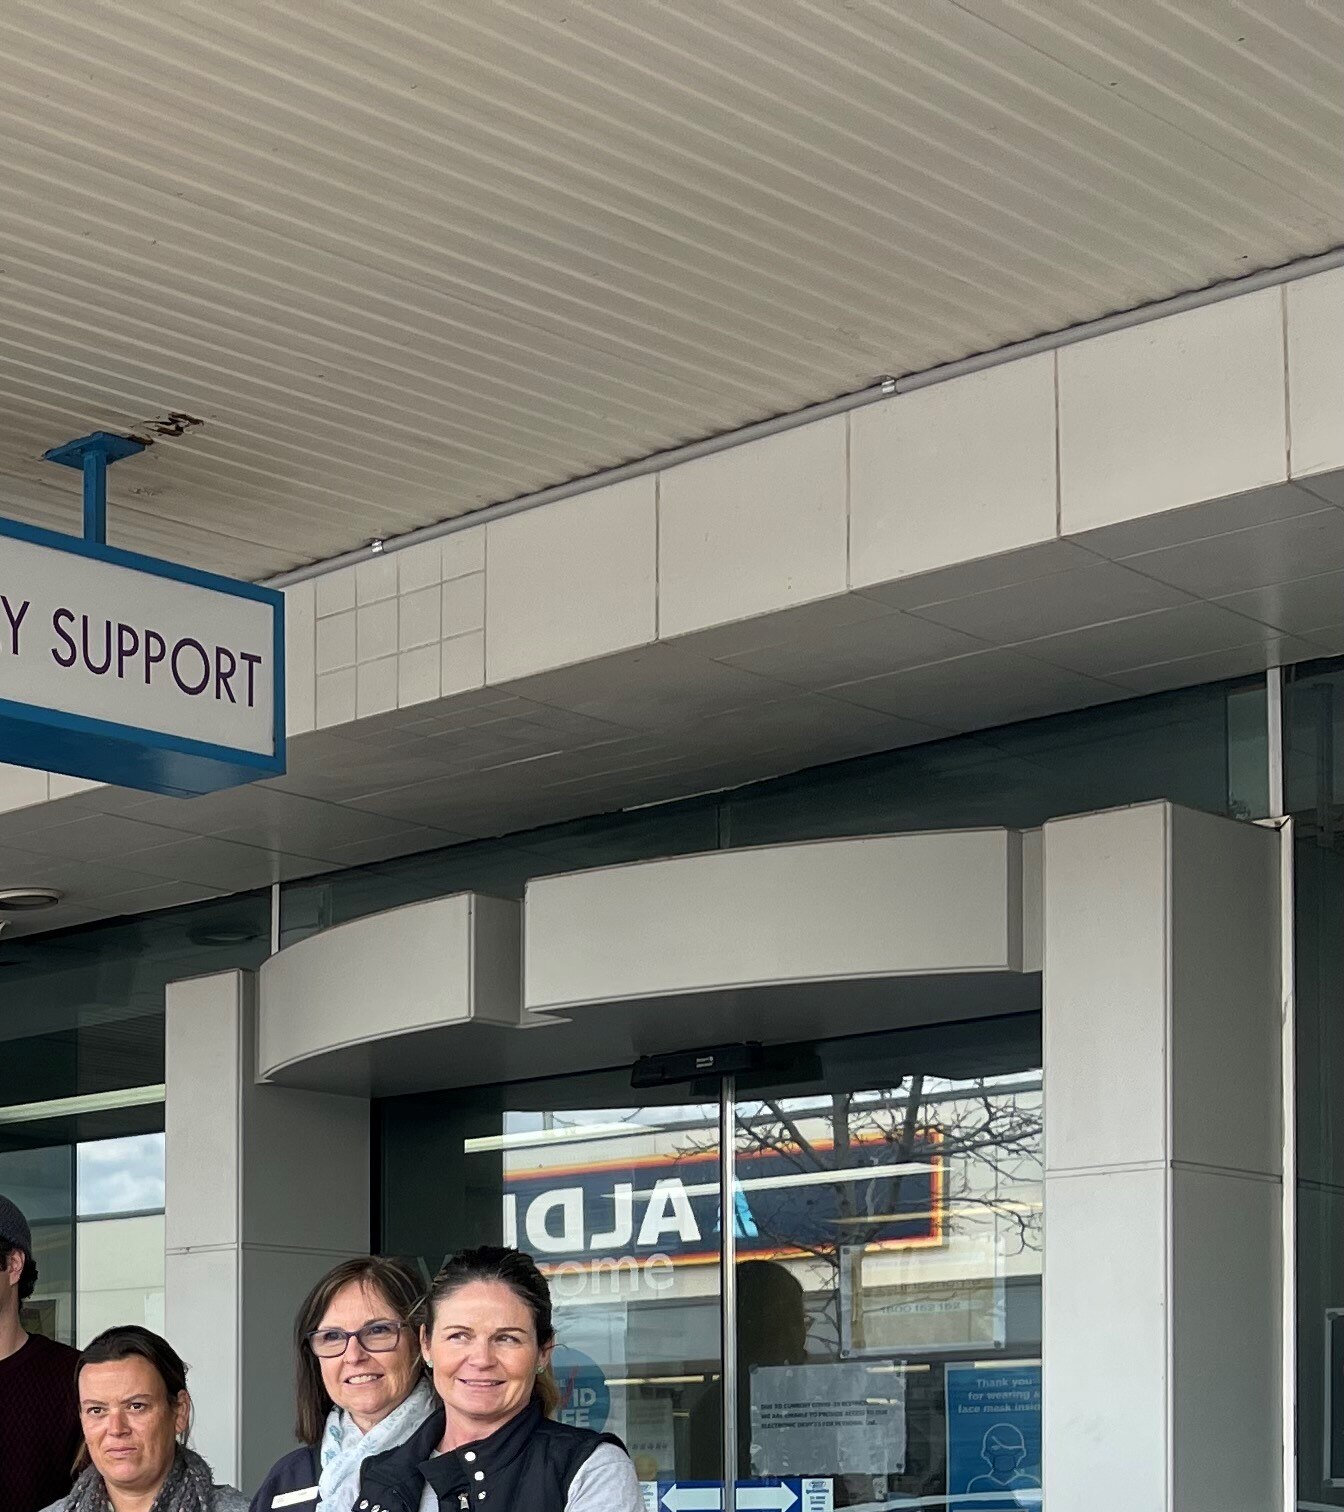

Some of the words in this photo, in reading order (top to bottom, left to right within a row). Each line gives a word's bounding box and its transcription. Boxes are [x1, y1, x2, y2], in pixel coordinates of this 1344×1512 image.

[50, 608, 263, 709] SUPPORT
[976, 1377, 1008, 1388] Thank
[1011, 1378, 1032, 1388] you
[968, 1391, 983, 1400] for
[986, 1390, 1030, 1401] wearing
[958, 1404, 981, 1413] face
[983, 1403, 1011, 1412] mask
